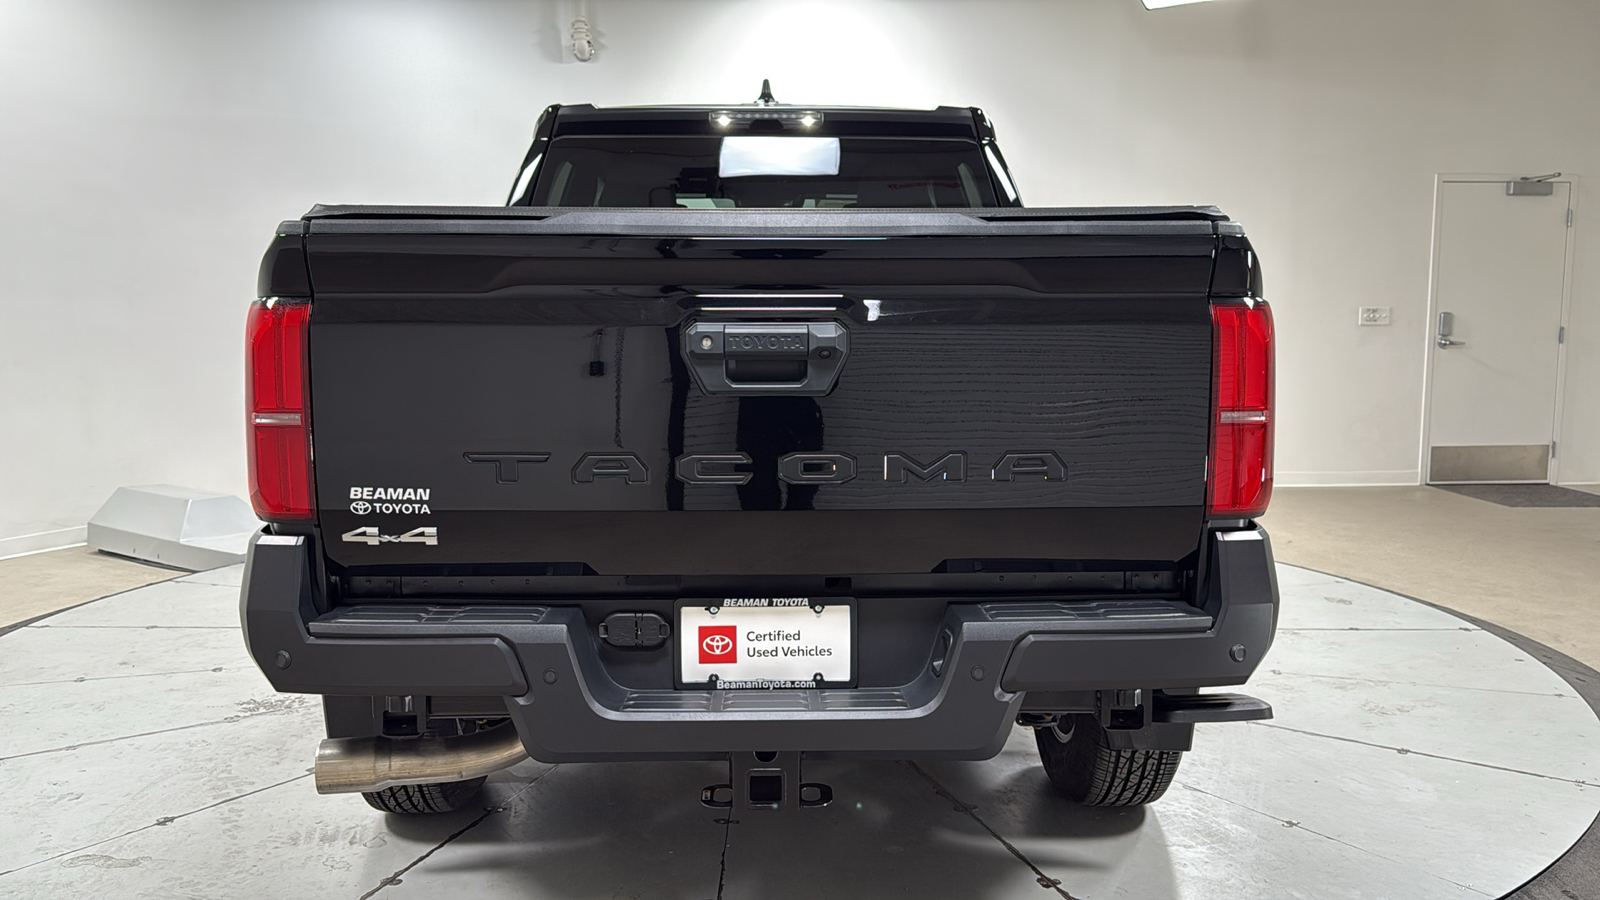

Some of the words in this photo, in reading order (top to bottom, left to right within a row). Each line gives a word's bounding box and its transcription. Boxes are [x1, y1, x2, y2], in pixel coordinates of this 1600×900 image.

[728, 335, 805, 349] TOYOTA
[463, 450, 1068, 485] TACOMA
[349, 487, 431, 501] BEAMAN
[373, 503, 431, 514] TOYOTA
[723, 598, 769, 607] BEAMAN
[772, 598, 809, 607] TOYOTA
[746, 630, 801, 642] Certified
[747, 647, 778, 658] Used
[781, 645, 833, 657] Vehicles
[716, 680, 816, 690] BeamanToyota.com
